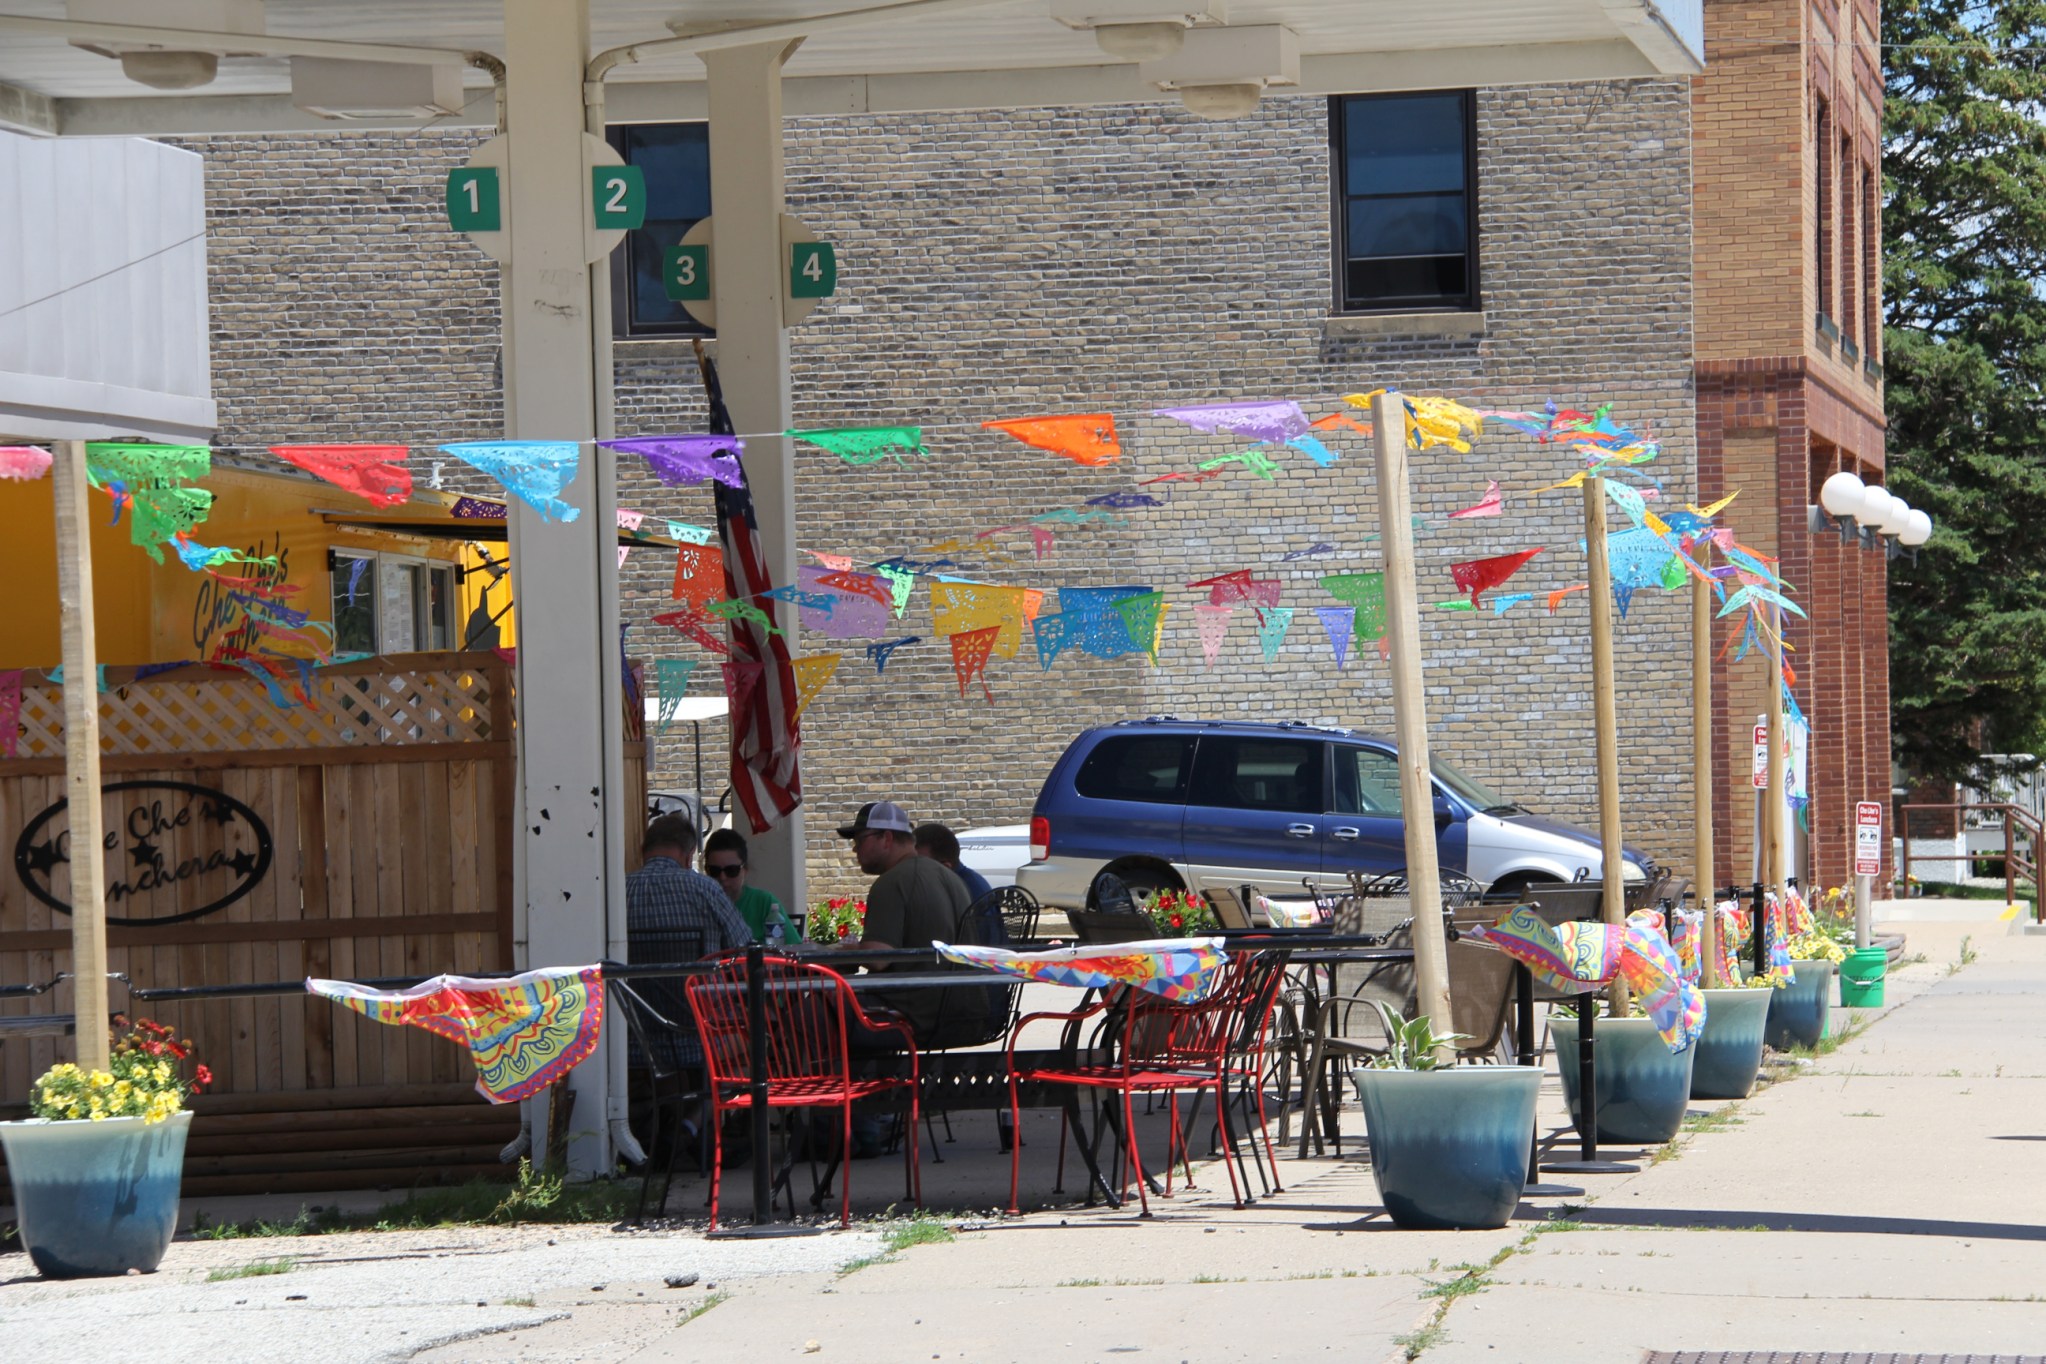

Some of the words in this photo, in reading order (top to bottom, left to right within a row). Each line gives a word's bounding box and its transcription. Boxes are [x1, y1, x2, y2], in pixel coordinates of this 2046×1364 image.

[462, 179, 480, 214] 1
[604, 178, 628, 213] 2
[676, 255, 696, 286] 3
[802, 252, 823, 282] 4
[55, 830, 119, 863] Ce
[106, 849, 229, 903] nchera
